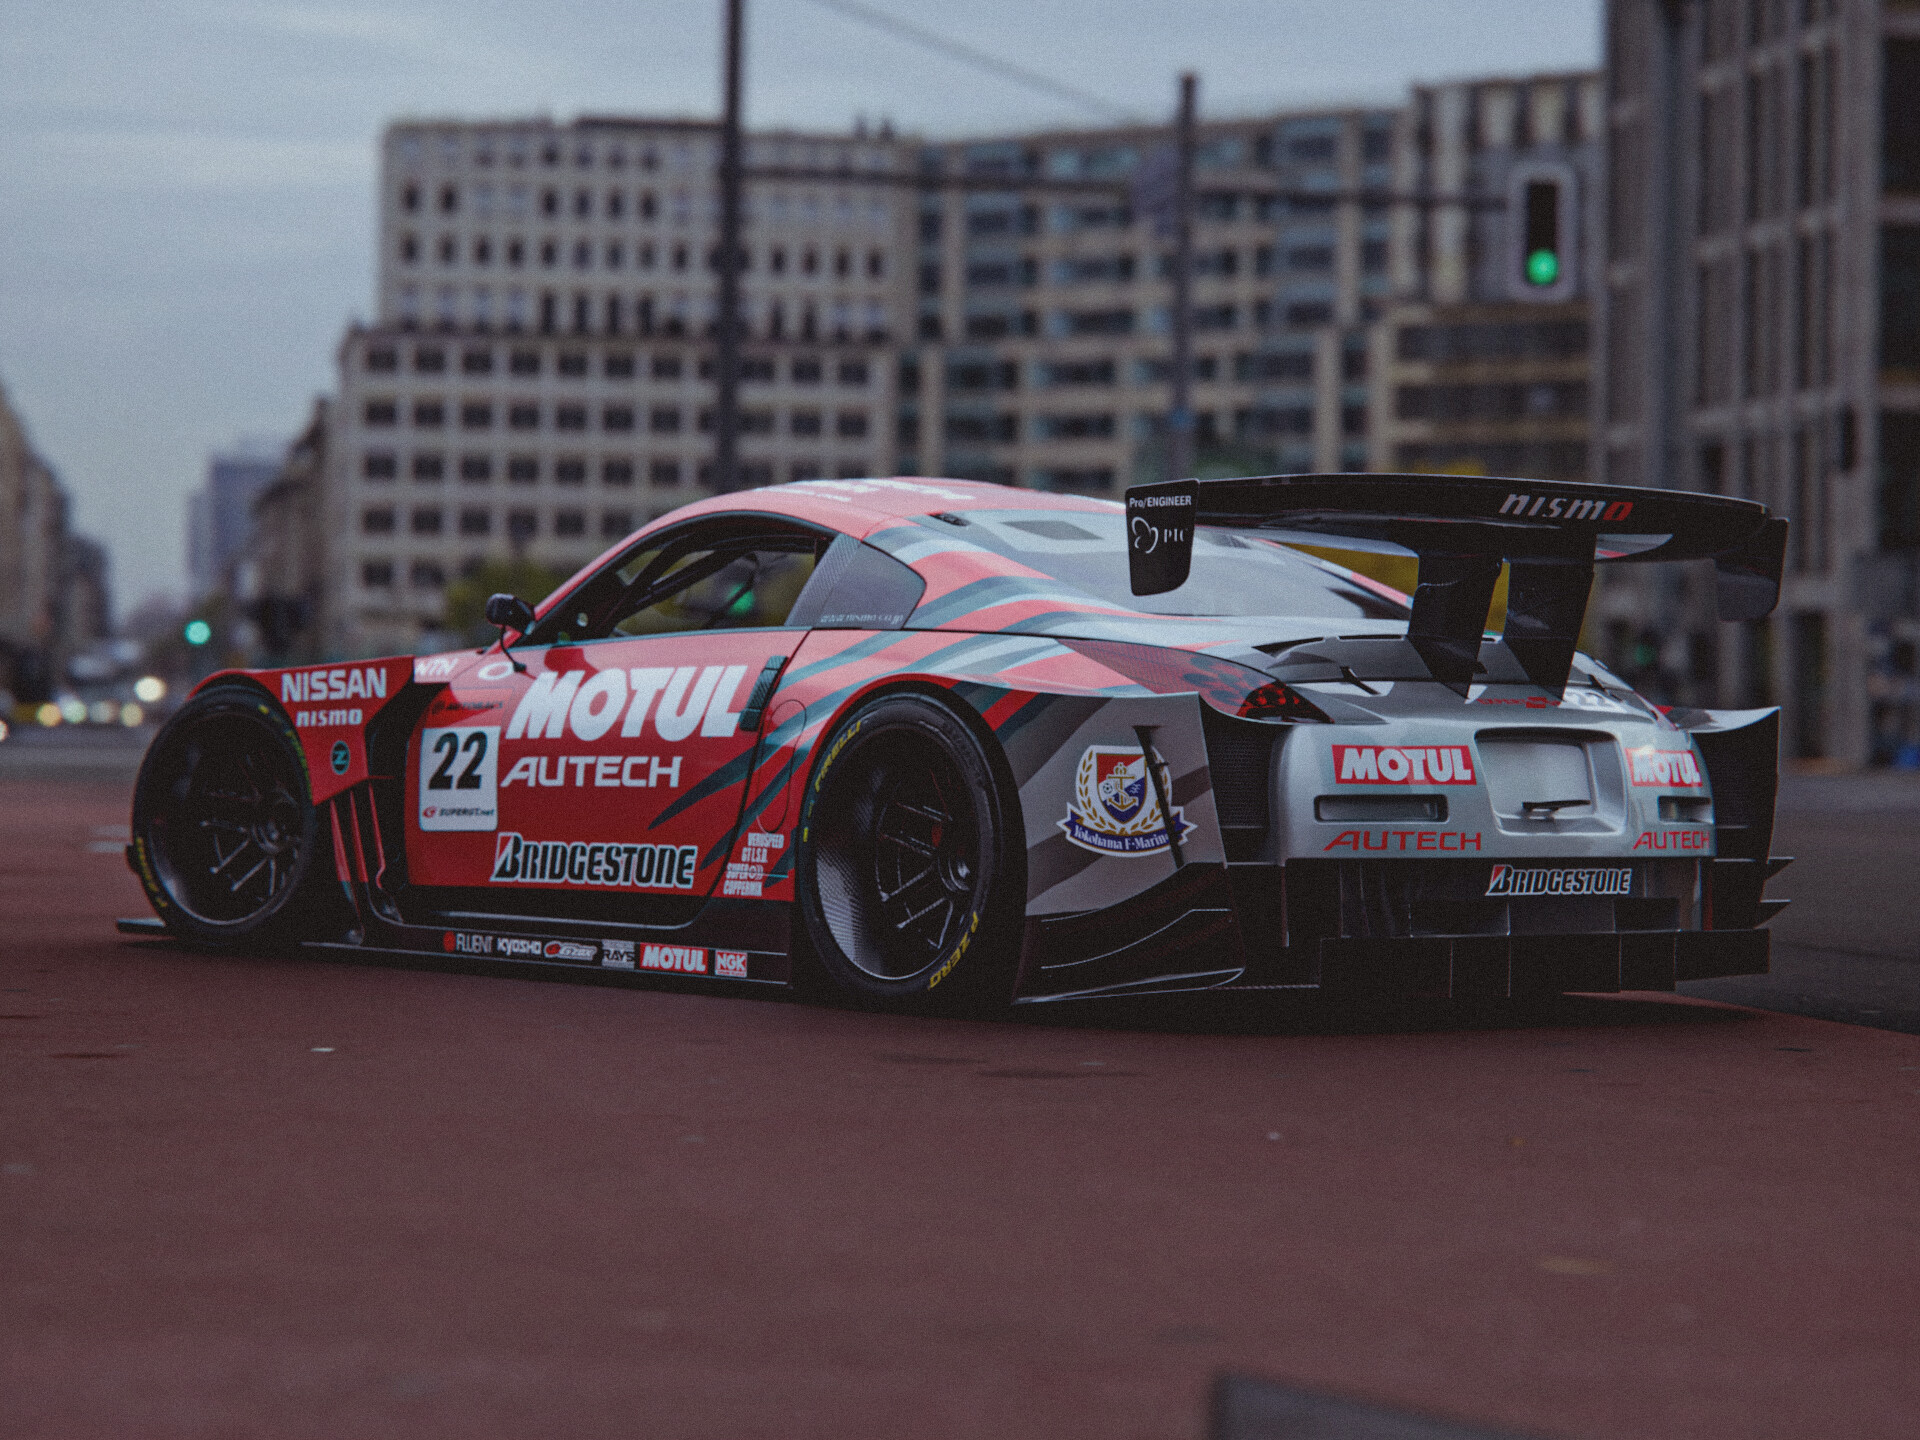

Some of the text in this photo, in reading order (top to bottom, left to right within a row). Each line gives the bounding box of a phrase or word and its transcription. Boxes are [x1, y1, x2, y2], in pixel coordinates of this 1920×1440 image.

[1499, 493, 1634, 521] nismo
[281, 667, 387, 703] NISSAN
[296, 708, 363, 728] nismo
[505, 664, 749, 742] MOTUL
[428, 731, 489, 790] 22
[501, 755, 683, 788] AUTECH
[1340, 747, 1472, 783] MOTUL
[1631, 750, 1702, 785] MOTUL
[1074, 824, 1123, 850] Yokohama
[1323, 830, 1482, 852] AUTECH
[1632, 830, 1710, 850] AUTECH
[489, 832, 698, 889] BRIDGESTONE
[1485, 864, 1633, 896] BRIDGESTONE
[602, 949, 635, 963] RAYS
[642, 945, 706, 972] MOTUL
[717, 953, 746, 971] NGK
